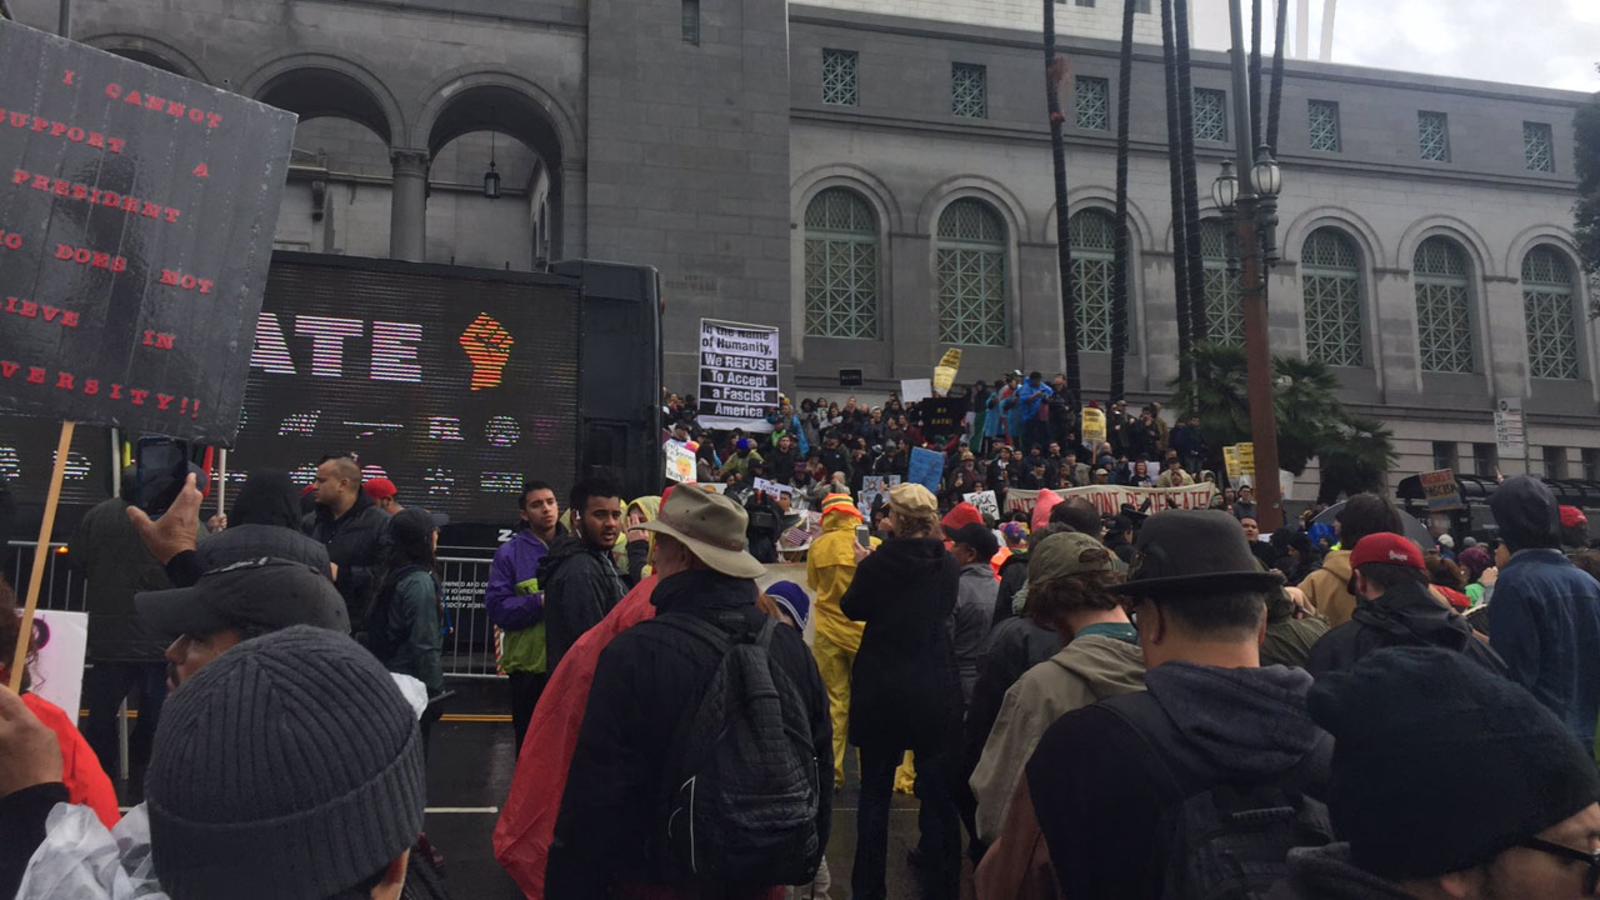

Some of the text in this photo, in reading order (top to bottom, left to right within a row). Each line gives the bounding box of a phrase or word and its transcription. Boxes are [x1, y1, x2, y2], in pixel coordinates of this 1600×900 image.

[63, 70, 223, 128] I CANNOT
[192, 162, 210, 178] A
[12, 169, 180, 224] PRESIDENT
[55, 244, 127, 273] DOES
[160, 269, 214, 295] NOT
[0, 297, 176, 350] IEVE IN
[702, 321, 770, 341] In the Name
[702, 336, 772, 356] of Humanity,
[704, 353, 774, 371] We REFUSE
[711, 370, 768, 388] To Accept
[0, 361, 201, 419] VERSITY!!
[712, 387, 766, 402] a Fascist
[714, 402, 764, 418] America
[466, 580, 480, 588] AND
